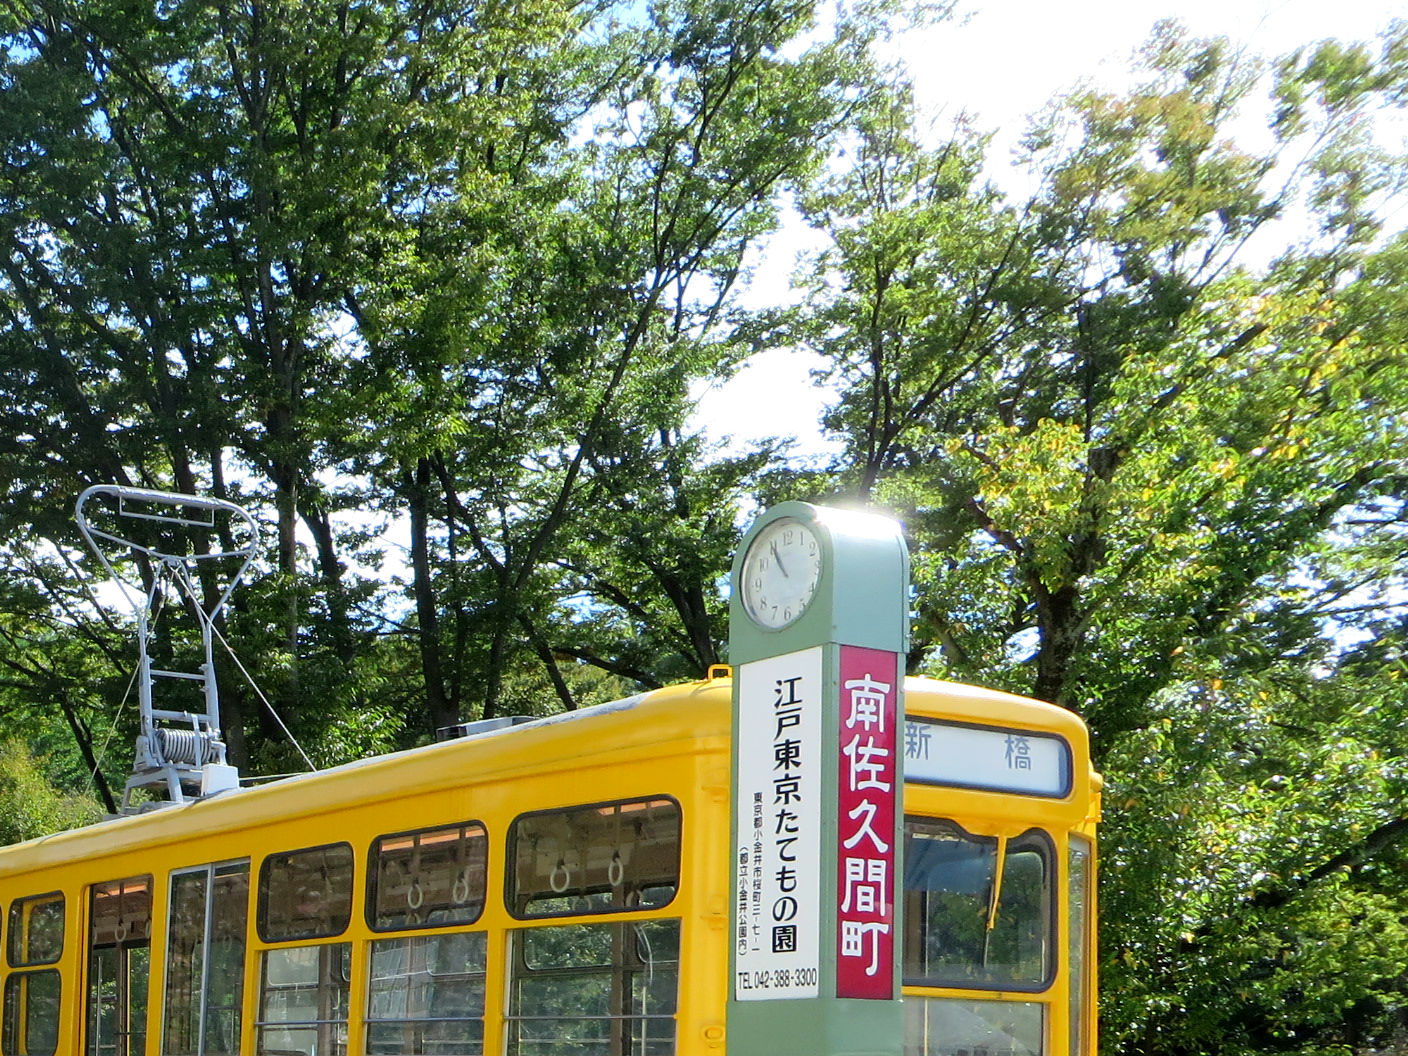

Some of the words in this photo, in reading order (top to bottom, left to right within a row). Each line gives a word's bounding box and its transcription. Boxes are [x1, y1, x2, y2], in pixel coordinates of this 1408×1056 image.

[772, 676, 803, 953] 江戸東京たてもの園
[841, 673, 891, 977] 南佐久間町
[738, 971, 752, 990] TEL
[754, 968, 817, 989] 042-388-3300
